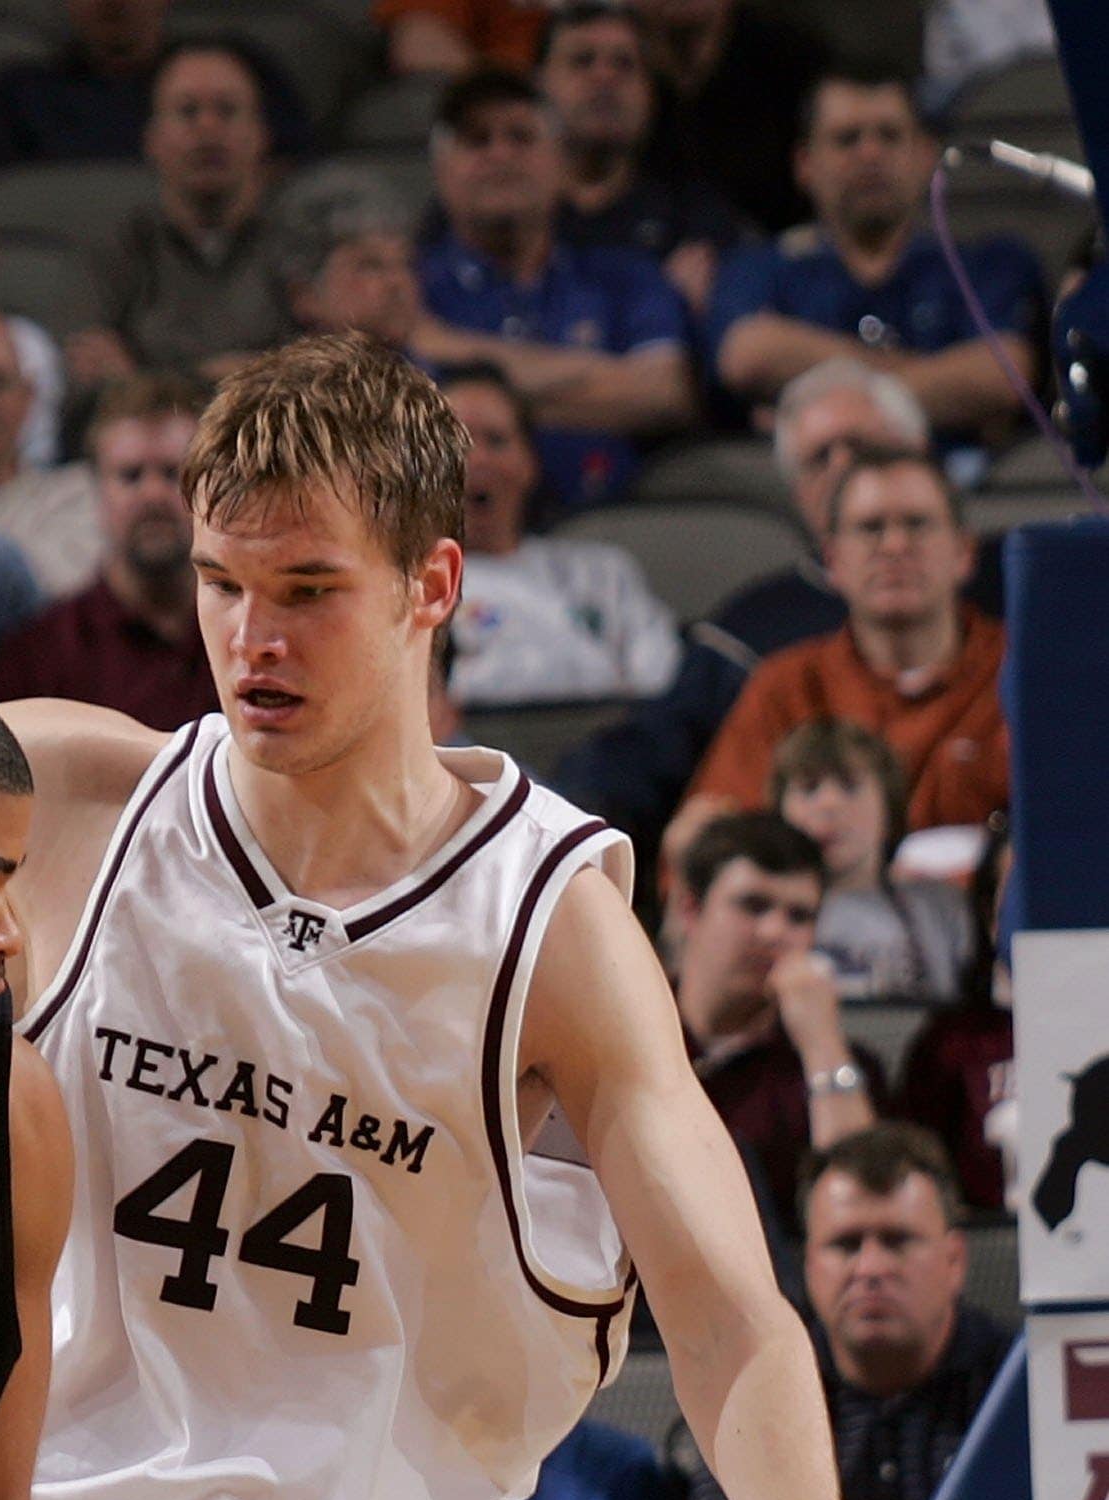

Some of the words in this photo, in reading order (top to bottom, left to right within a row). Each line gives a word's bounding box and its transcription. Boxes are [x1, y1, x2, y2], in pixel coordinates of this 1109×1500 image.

[95, 1027, 294, 1129] TEXAS
[308, 1094, 435, 1174] A&M
[113, 1138, 360, 1336] 44
